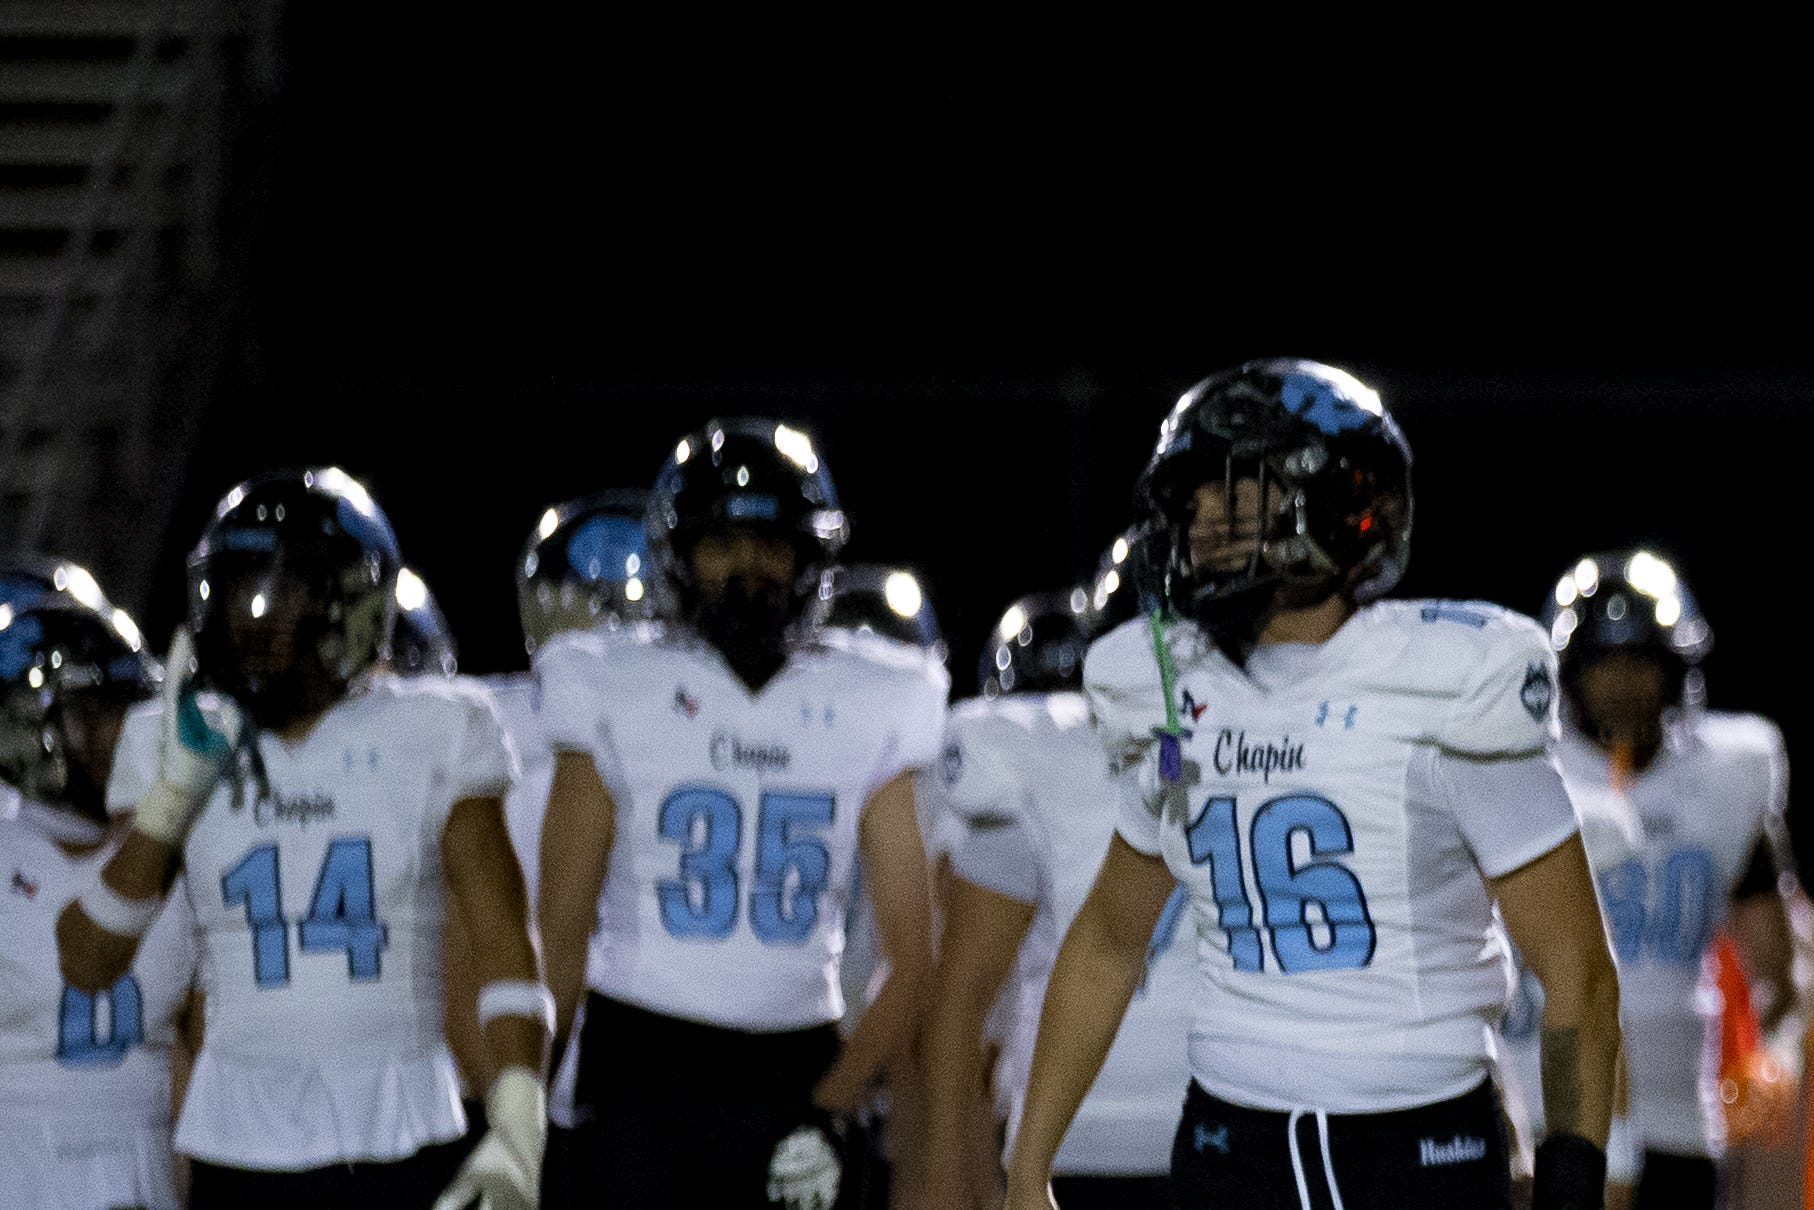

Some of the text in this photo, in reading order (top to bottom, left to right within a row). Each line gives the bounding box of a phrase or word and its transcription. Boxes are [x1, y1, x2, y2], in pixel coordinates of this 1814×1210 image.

[1213, 727, 1307, 784] Chapin
[219, 836, 389, 990] 14
[655, 784, 836, 944] 35
[1184, 787, 1377, 974] 16
